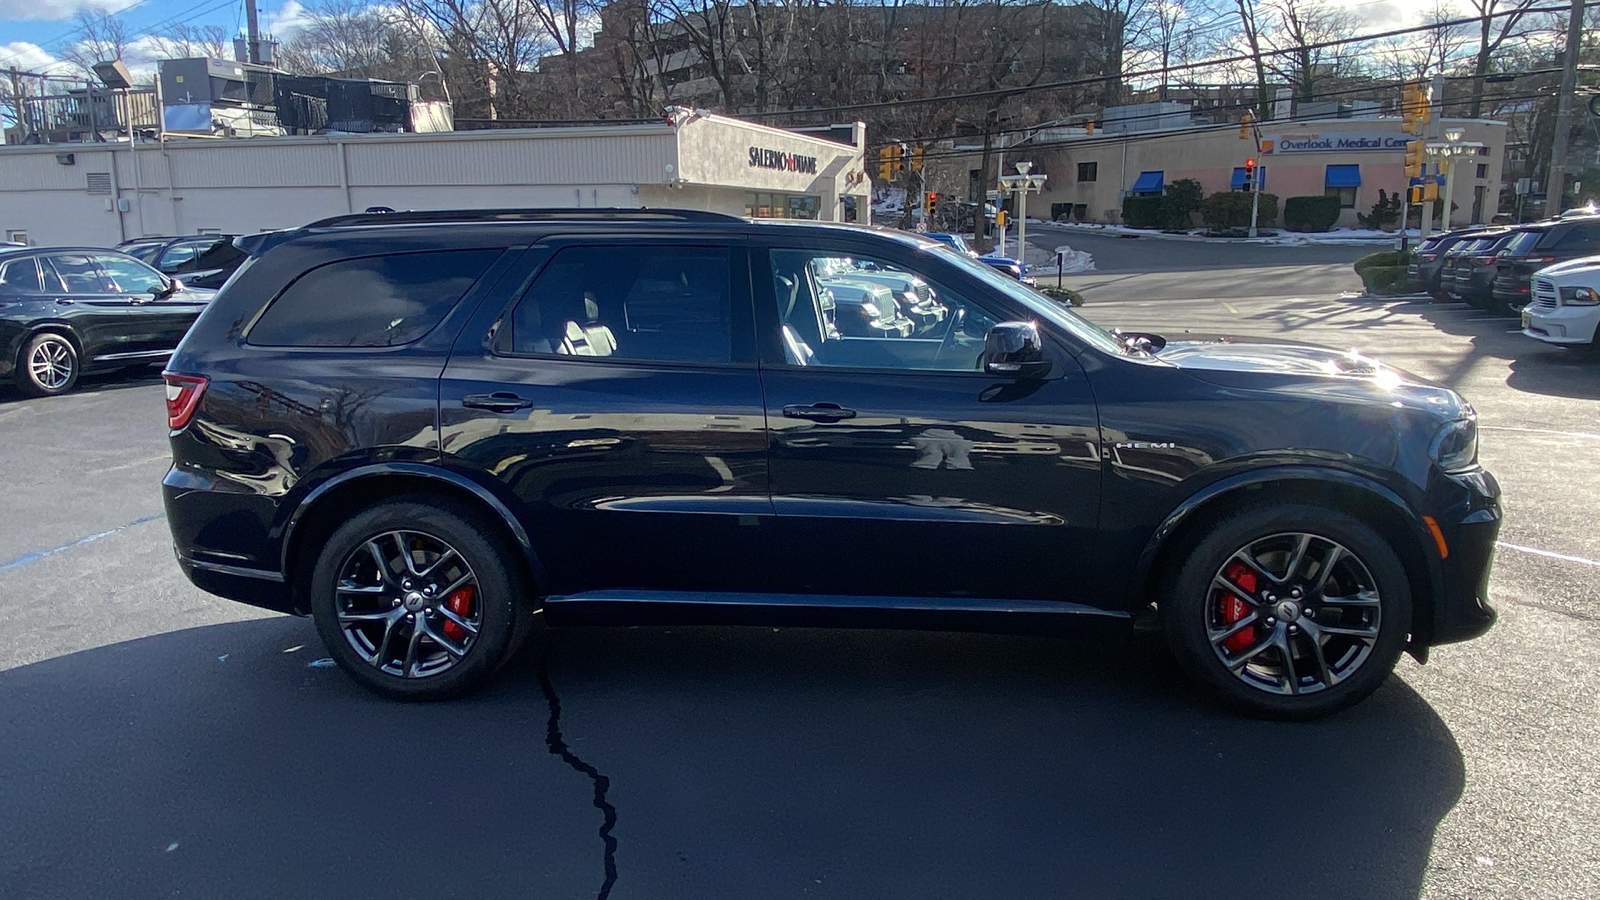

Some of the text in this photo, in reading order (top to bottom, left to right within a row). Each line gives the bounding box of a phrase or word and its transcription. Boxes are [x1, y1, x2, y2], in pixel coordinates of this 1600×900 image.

[1280, 137, 1413, 150] Overlook Medical Cent
[748, 146, 817, 175] SALERNO DUANE
